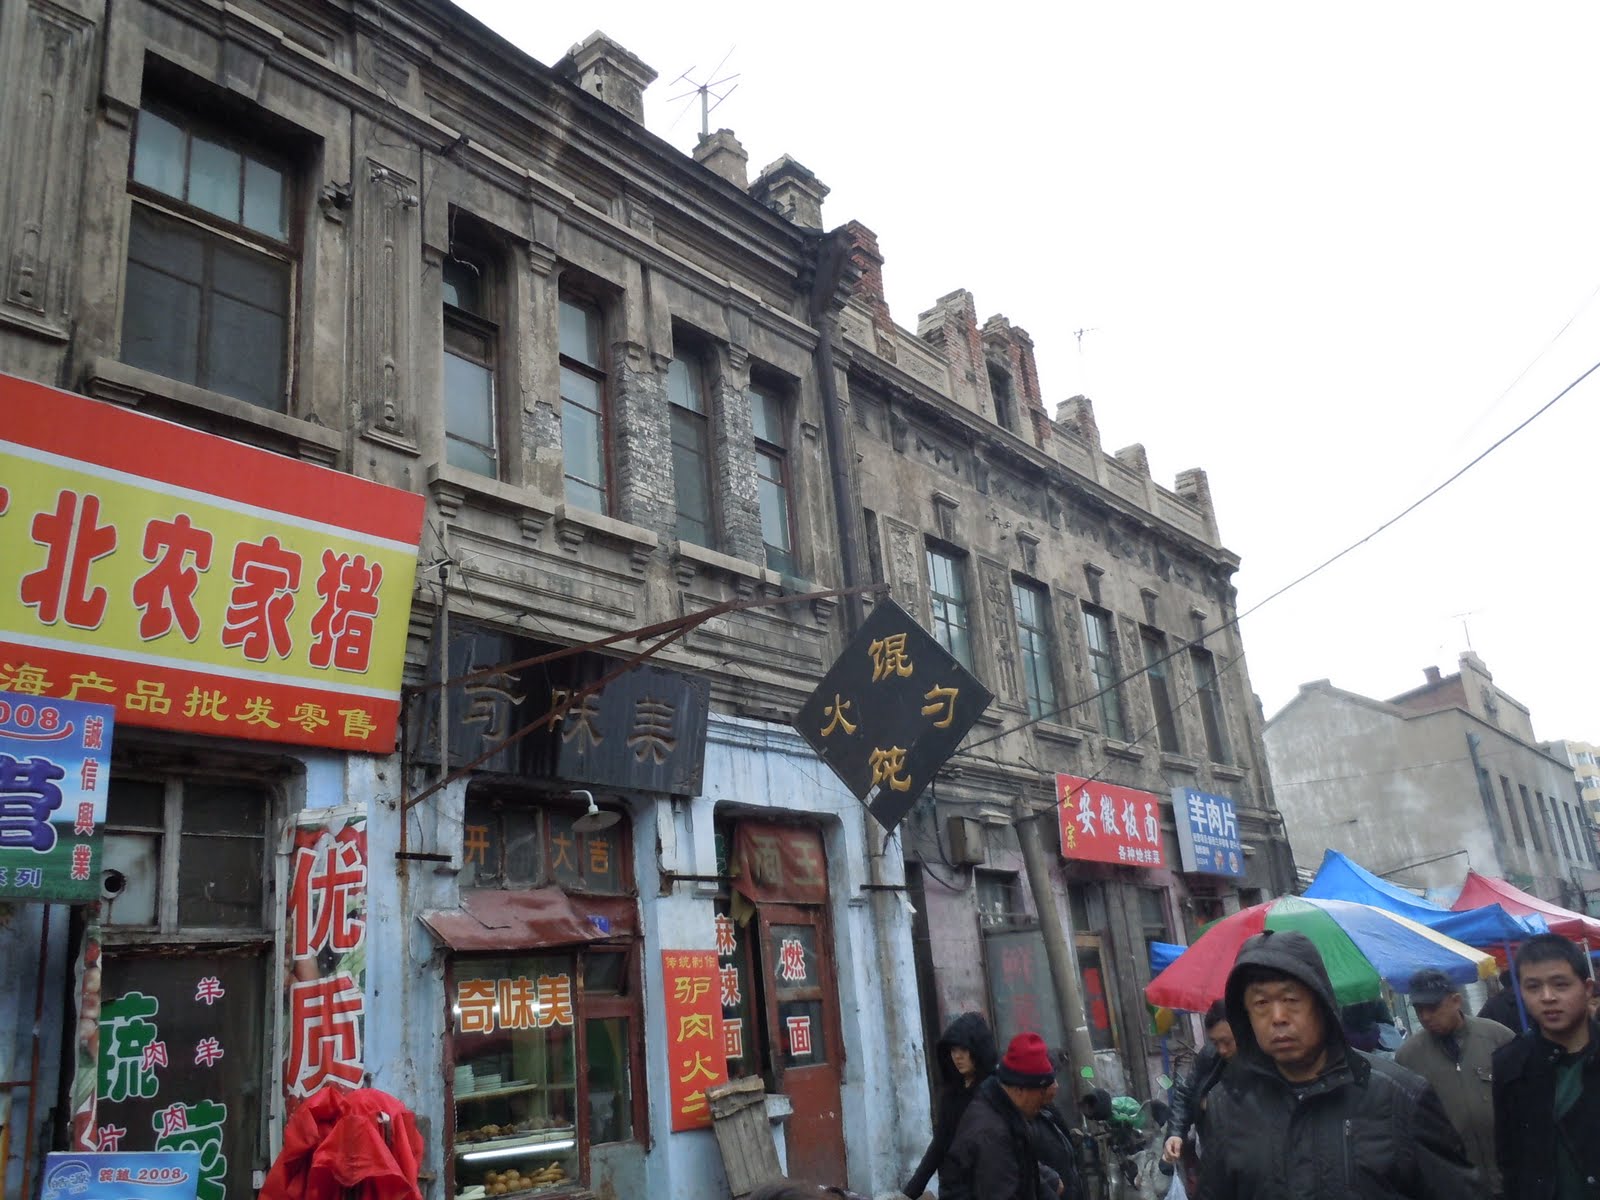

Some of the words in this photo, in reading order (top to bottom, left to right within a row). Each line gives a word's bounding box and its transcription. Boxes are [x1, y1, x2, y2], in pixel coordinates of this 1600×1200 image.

[0, 486, 384, 674] 北农家猪
[0, 662, 378, 740] 海产品批发零售
[1076, 788, 1159, 847] 安徽板面
[1188, 793, 1237, 840] 羊肉片
[287, 845, 367, 1097] 优质
[457, 973, 575, 1035] 奇味美
[781, 939, 813, 1057] 燃面
[138, 1167, 182, 1181] 2008
